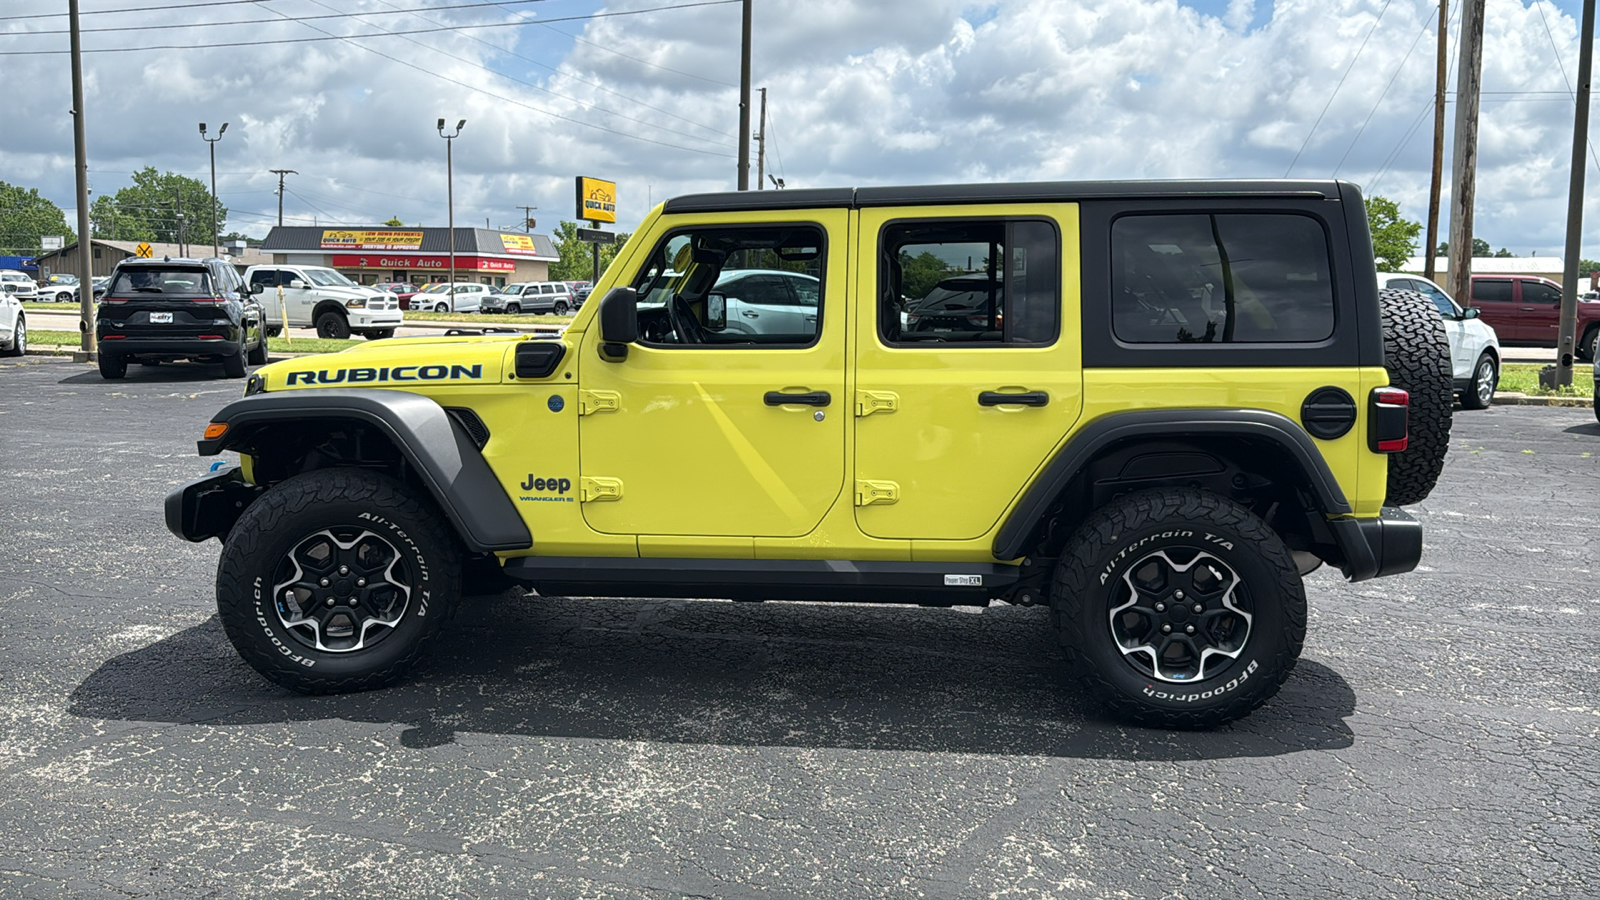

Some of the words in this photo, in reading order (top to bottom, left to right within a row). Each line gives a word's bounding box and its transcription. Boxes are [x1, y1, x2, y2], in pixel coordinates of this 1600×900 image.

[585, 200, 602, 210] QUICK
[602, 202, 616, 212] AUTO
[380, 258, 410, 267] Quick
[417, 259, 442, 267] Auto
[286, 364, 483, 386] RUBICON
[520, 474, 571, 494] Jeep
[358, 512, 430, 582] All-Terrain
[417, 590, 430, 617] T/A
[1100, 529, 1194, 586] All-Terrain
[1204, 532, 1235, 552] T/A
[969, 576, 980, 584] XL
[253, 576, 317, 668] BFGoodrich
[1142, 659, 1259, 703] BFGoodrich
